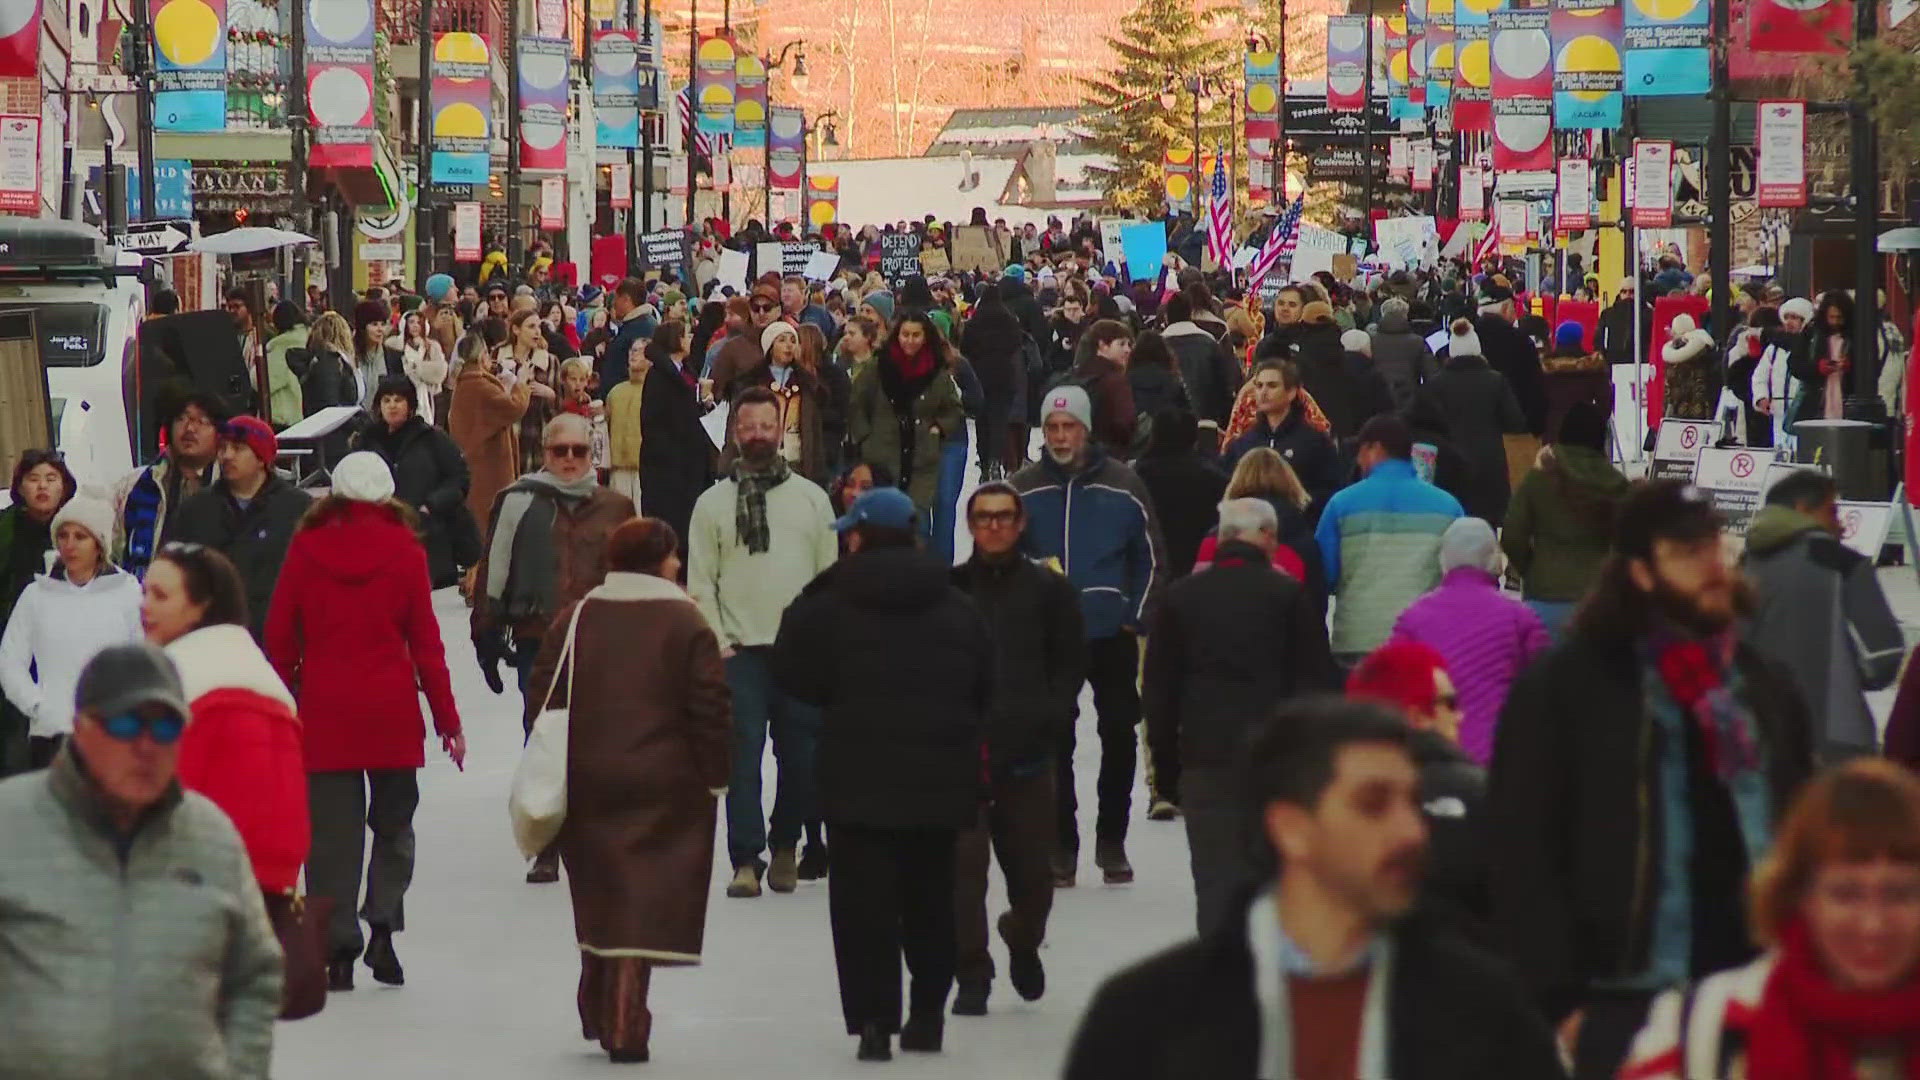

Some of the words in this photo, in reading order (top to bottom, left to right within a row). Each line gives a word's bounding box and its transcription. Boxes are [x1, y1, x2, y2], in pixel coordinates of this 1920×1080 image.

[1655, 26, 1709, 37] Sundance
[1633, 37, 1658, 48] Film
[1659, 36, 1702, 47] Festival
[137, 232, 162, 246] WAY
[882, 234, 917, 249] DEFEND
[892, 248, 909, 257] AND
[882, 257, 920, 271] PROTECT
